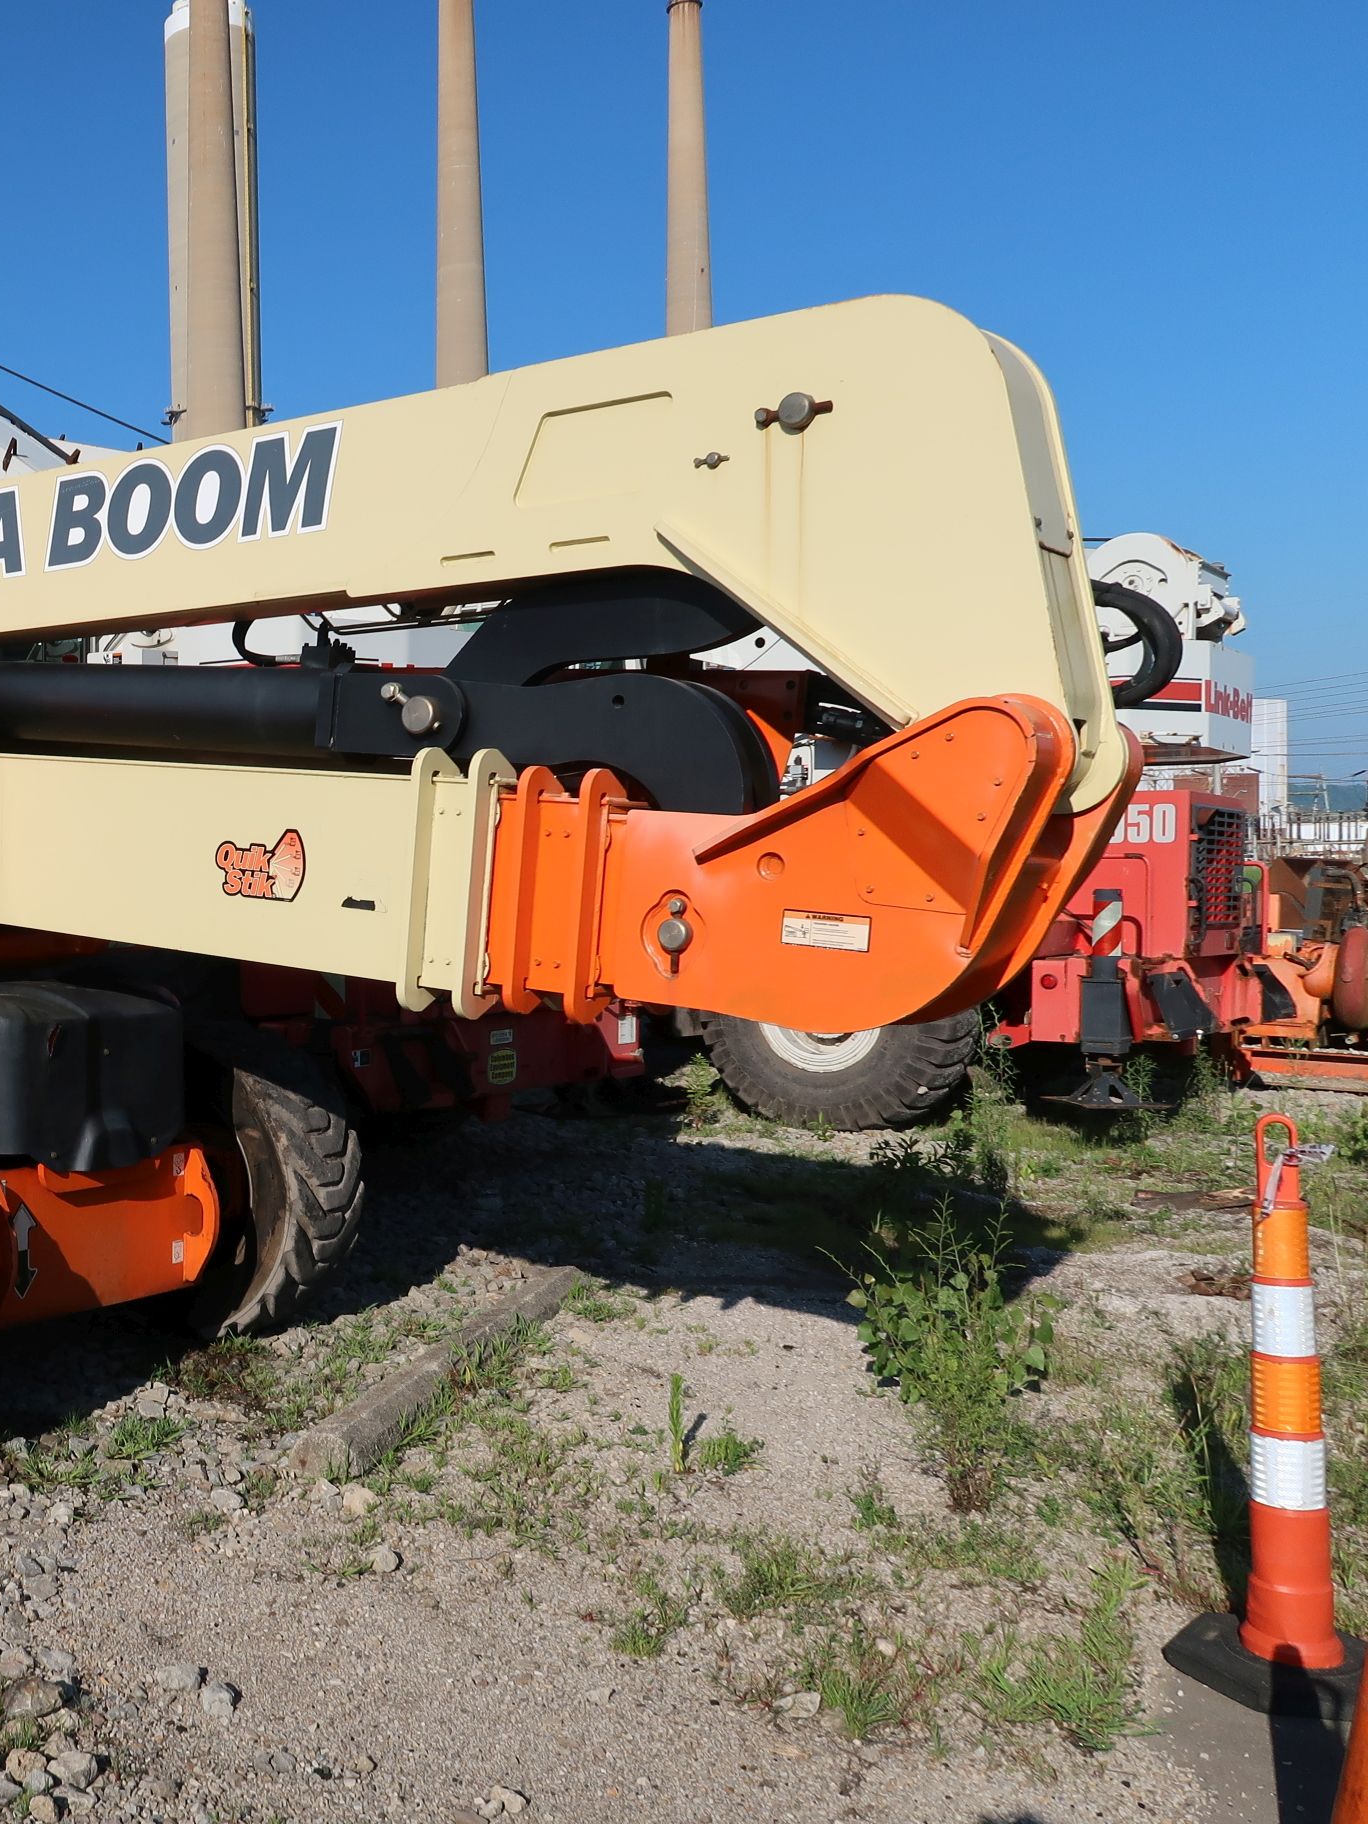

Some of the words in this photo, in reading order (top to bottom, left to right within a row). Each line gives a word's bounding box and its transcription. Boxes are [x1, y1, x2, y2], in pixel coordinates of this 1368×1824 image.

[45, 423, 341, 569] BOOM
[1204, 679, 1253, 724] Link-Belt
[216, 843, 272, 873] Quik
[223, 869, 275, 897] Stik
